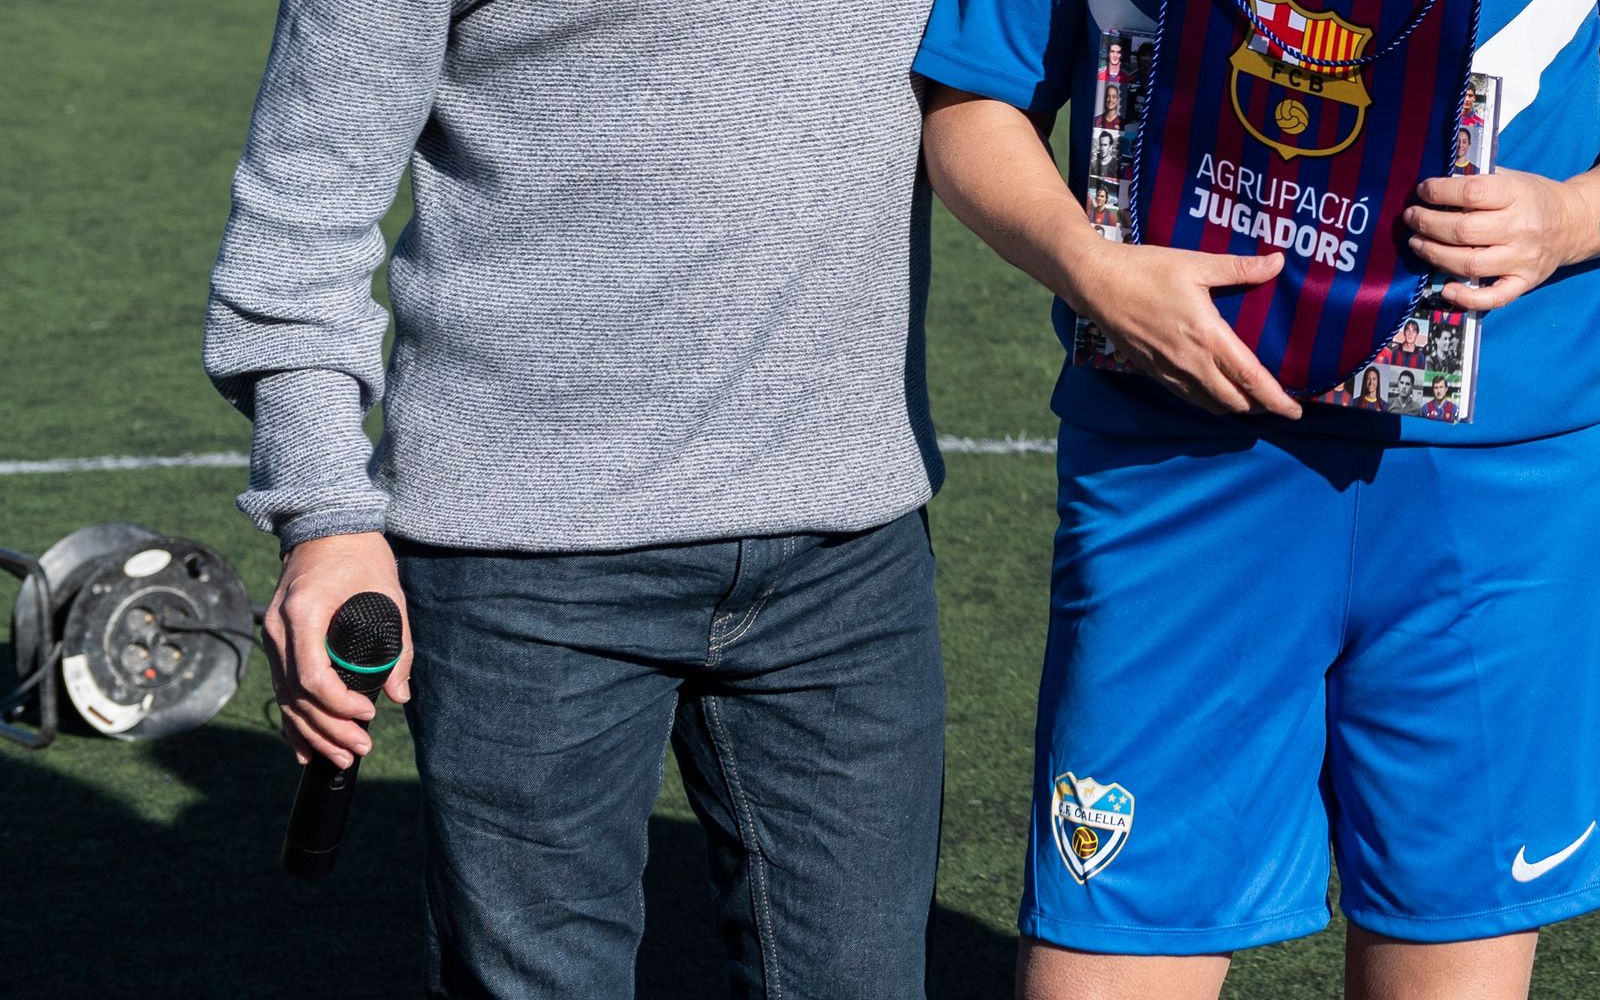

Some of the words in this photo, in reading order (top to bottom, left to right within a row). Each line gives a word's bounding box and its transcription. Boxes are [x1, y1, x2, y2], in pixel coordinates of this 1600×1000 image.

[1270, 62, 1325, 93] FCB
[1196, 153, 1369, 235] AGRUPACIÓ
[1189, 187, 1359, 272] JUGADORS
[1074, 808, 1126, 827] CALELLA
